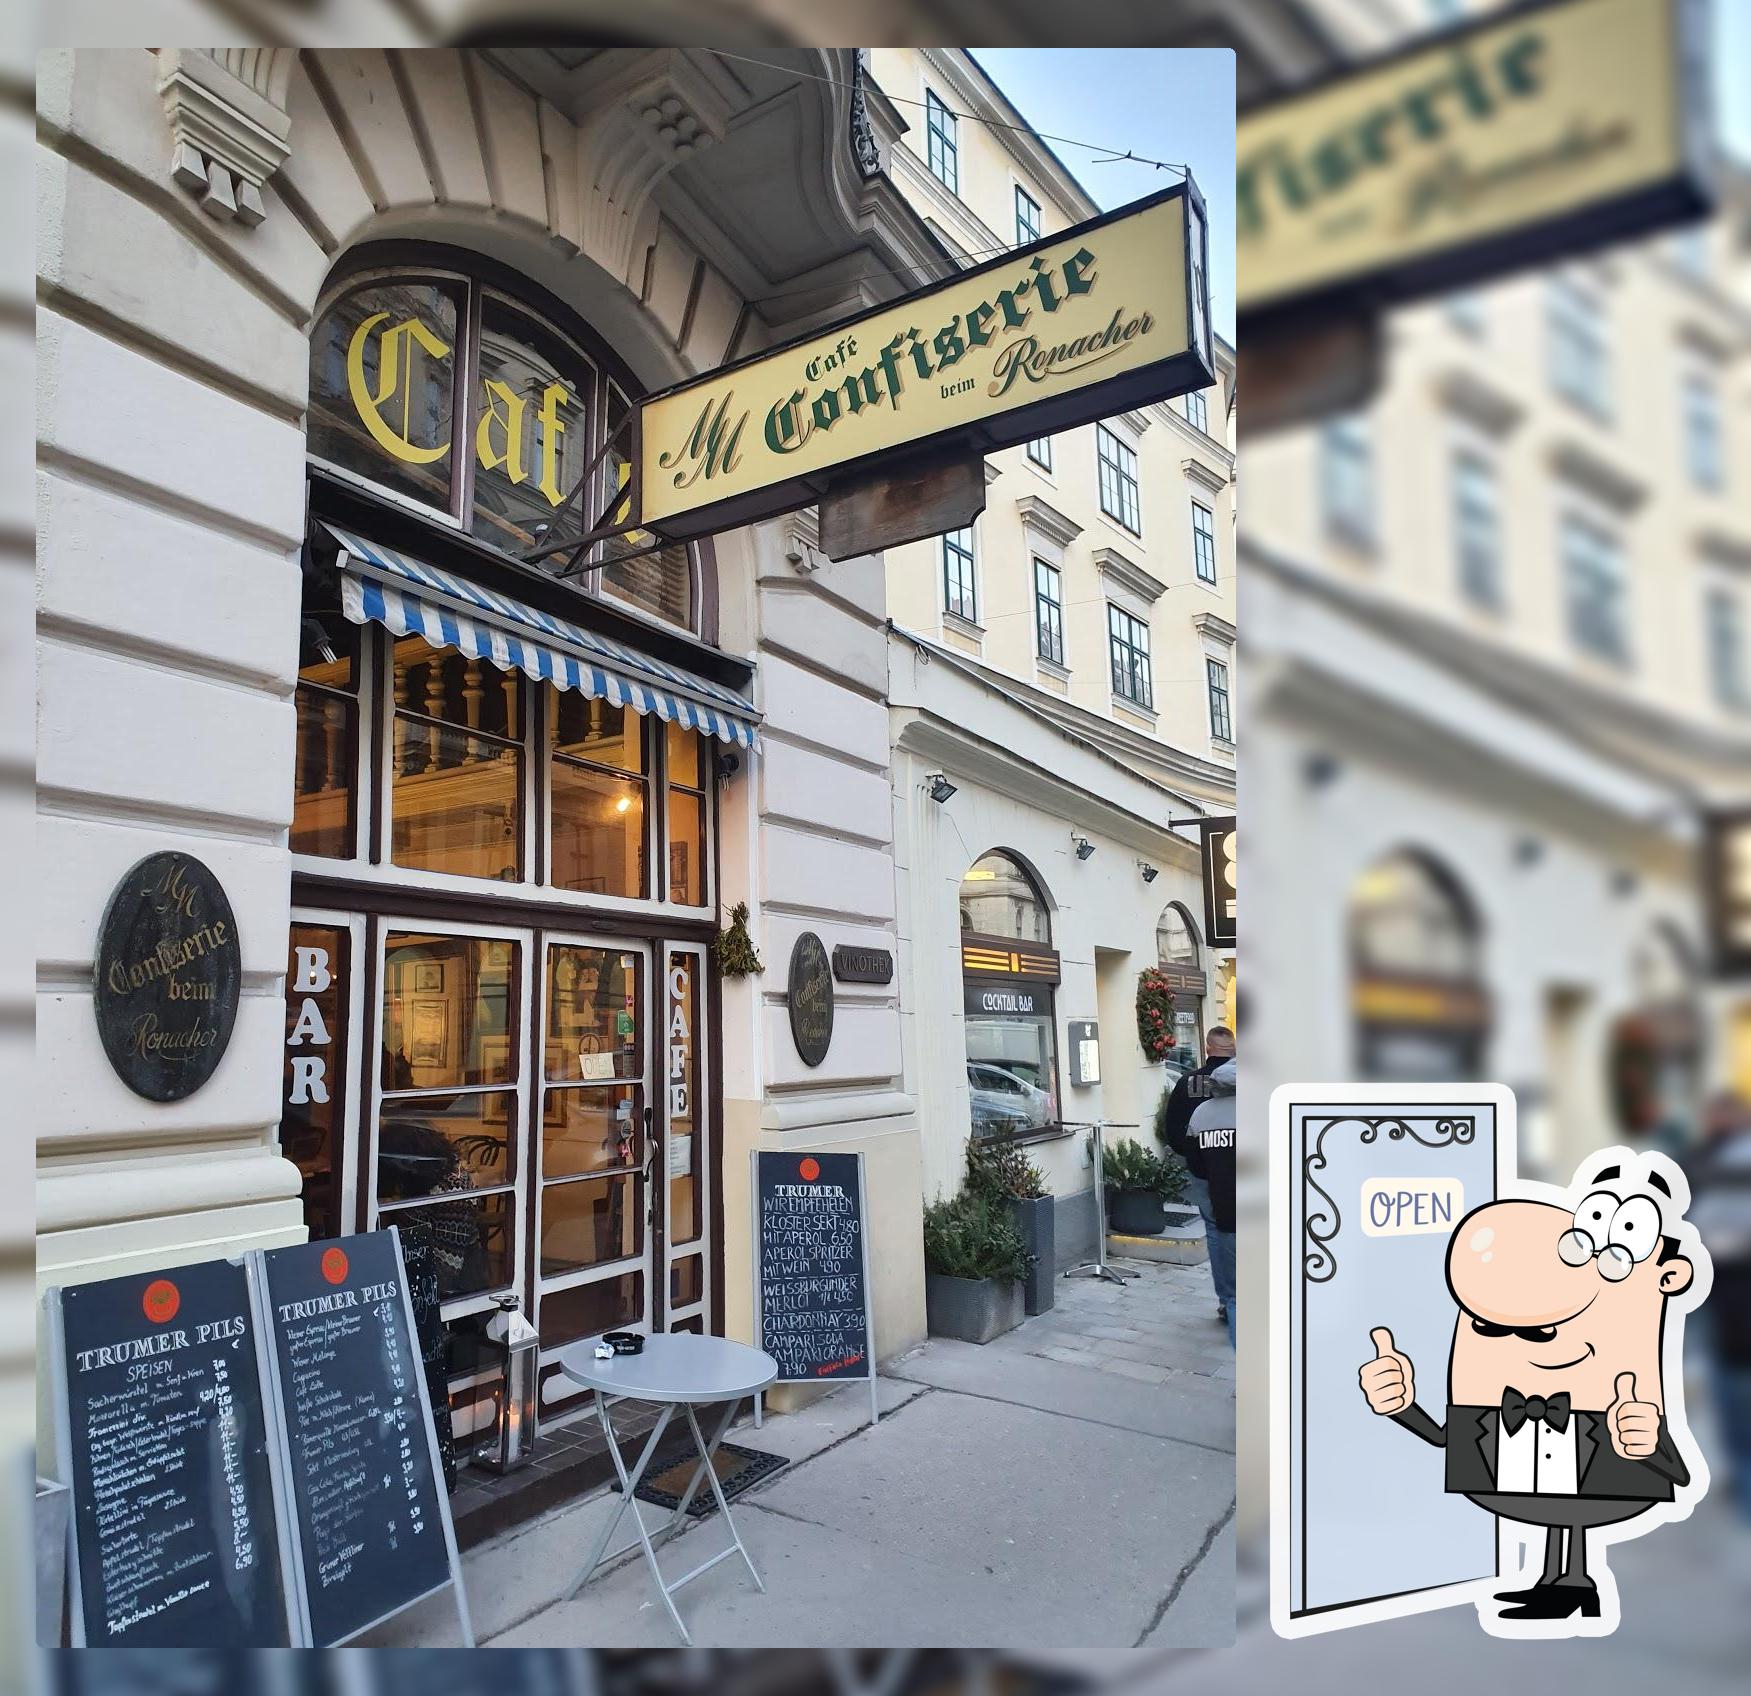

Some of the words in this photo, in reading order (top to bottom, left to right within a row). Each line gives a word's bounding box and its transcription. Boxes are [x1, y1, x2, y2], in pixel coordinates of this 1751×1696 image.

[763, 246, 1098, 456] Confiserie
[804, 335, 860, 383] Café
[940, 376, 976, 400] beim
[987, 306, 1156, 399] Ronacher
[841, 952, 891, 975] VINOTHEK
[167, 973, 217, 1001] beim
[982, 993, 1018, 1012] COCKTAIL
[1018, 994, 1033, 1012] BAR
[286, 946, 332, 1105] BAR
[669, 966, 690, 1118] CAFE
[775, 1184, 845, 1197] TRUMER
[812, 1214, 840, 1231] SEKT
[783, 1231, 826, 1246] APEROL
[781, 1259, 810, 1274] WEIN
[278, 1290, 359, 1323] TRUMER
[360, 1280, 397, 1304] PILS
[76, 1329, 190, 1372] TRUMER
[195, 1316, 246, 1344] PILS
[126, 1359, 173, 1383] SPEISEN
